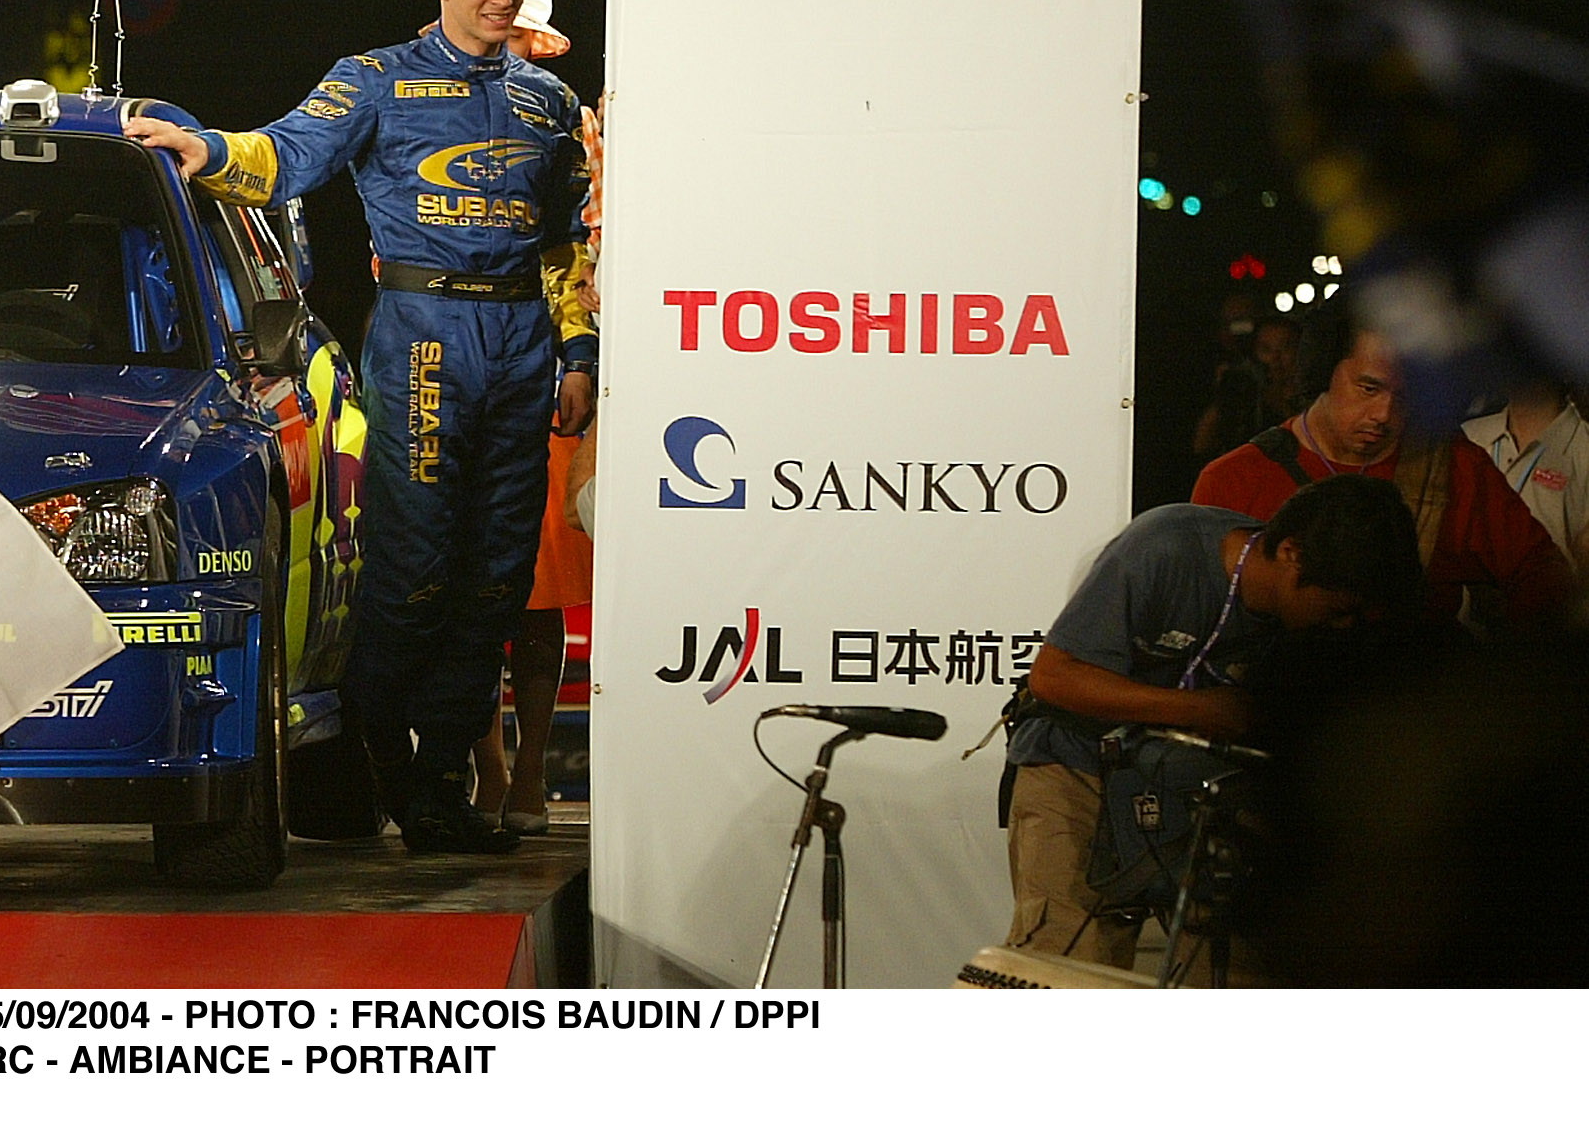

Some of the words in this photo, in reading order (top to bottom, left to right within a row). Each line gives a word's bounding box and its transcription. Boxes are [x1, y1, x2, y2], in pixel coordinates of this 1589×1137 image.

[416, 193, 540, 226] SUBARU
[663, 290, 1070, 356] TOSHIBA
[418, 340, 443, 484] SUBARU
[771, 459, 1069, 514] SANKYO
[198, 549, 252, 574] DENSO
[654, 609, 803, 704] JAL
